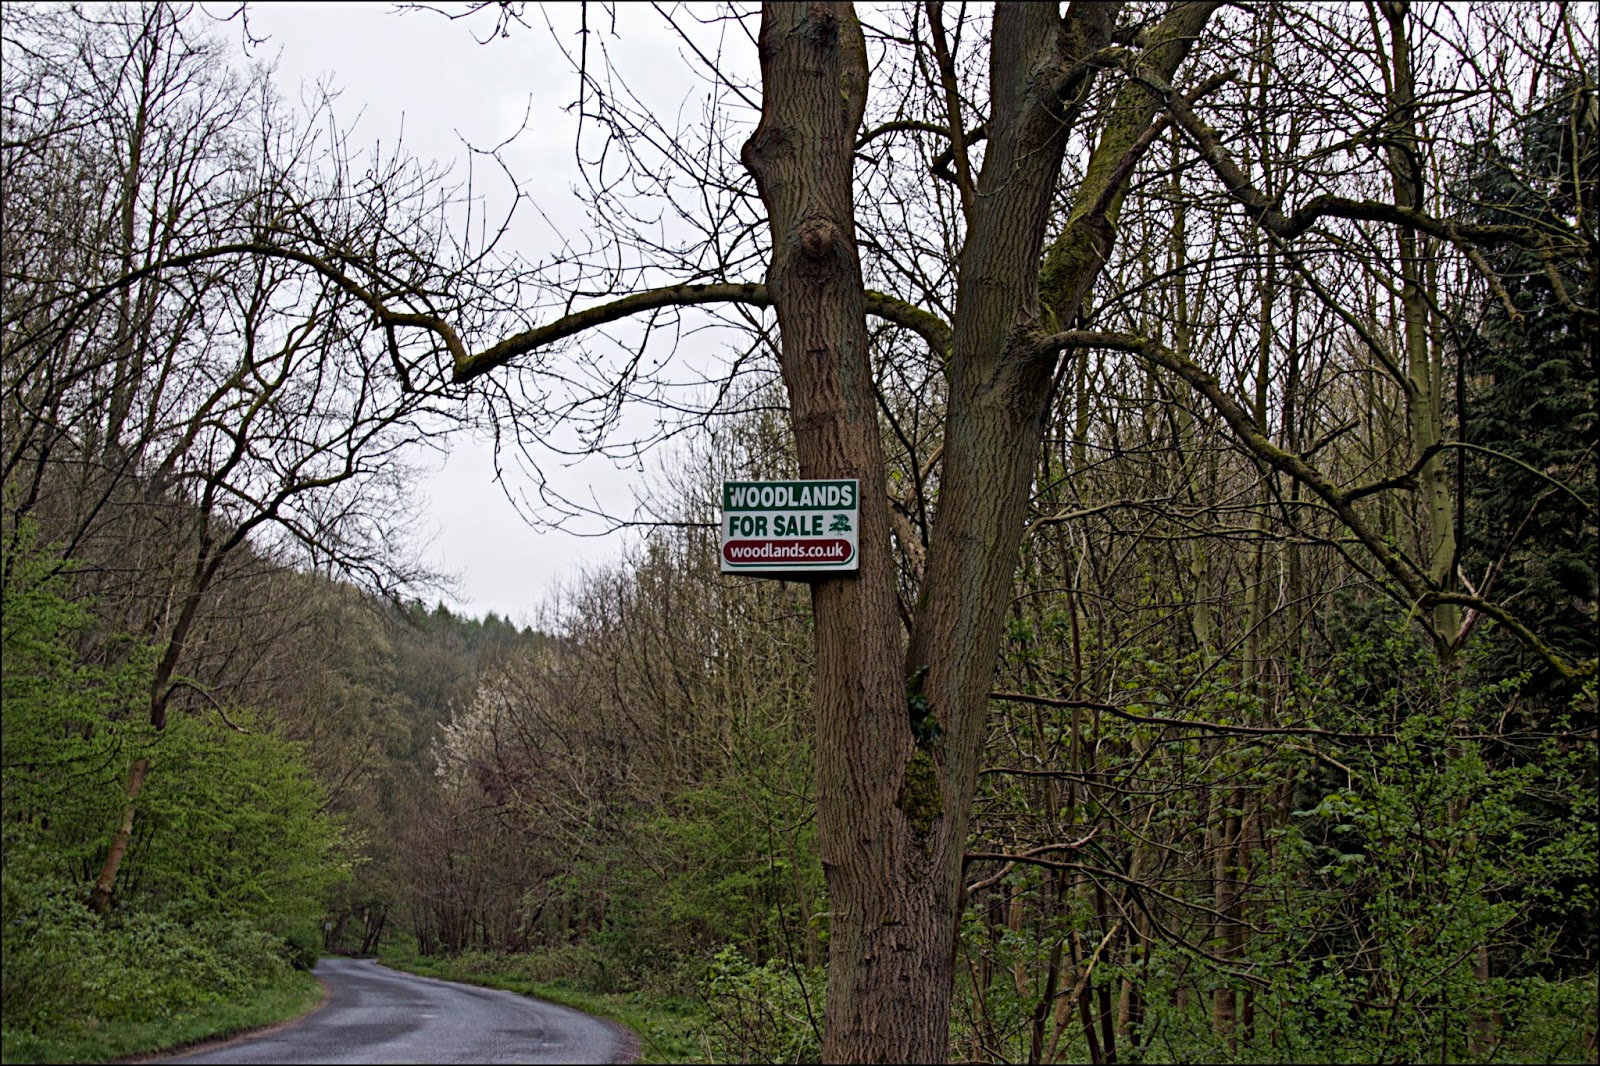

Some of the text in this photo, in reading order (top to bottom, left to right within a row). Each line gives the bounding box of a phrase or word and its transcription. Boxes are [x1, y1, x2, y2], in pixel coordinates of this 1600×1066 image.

[729, 485, 853, 508] WOODLANDS
[729, 515, 824, 537] FOR SALE
[730, 542, 844, 558] woodlands.co.uk
